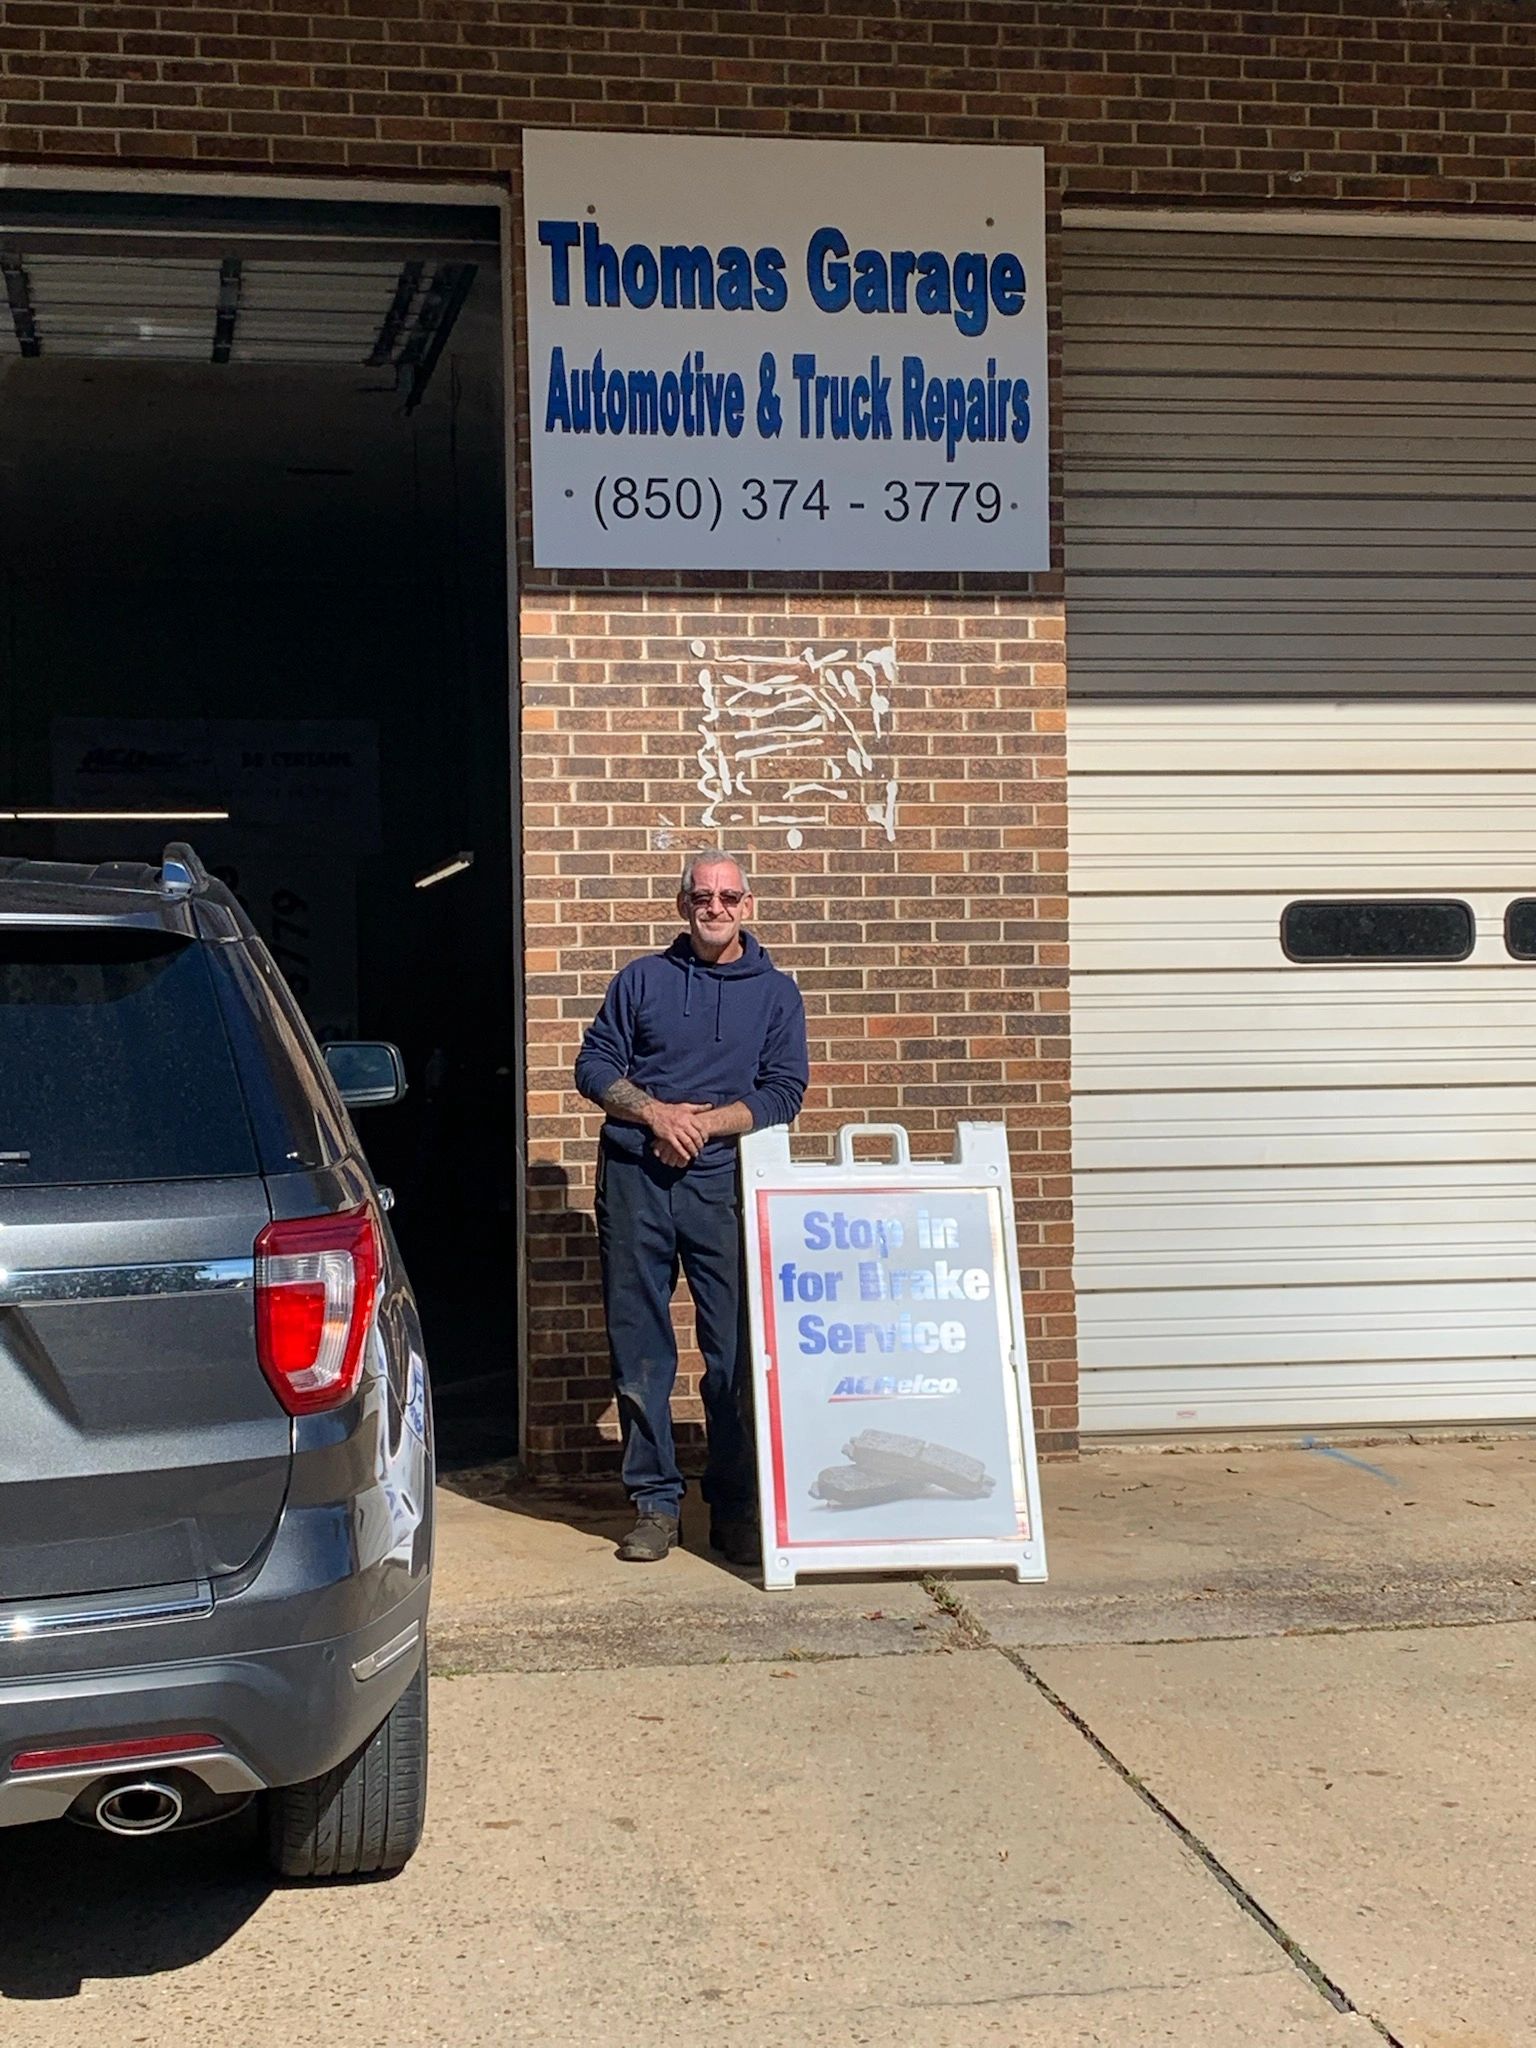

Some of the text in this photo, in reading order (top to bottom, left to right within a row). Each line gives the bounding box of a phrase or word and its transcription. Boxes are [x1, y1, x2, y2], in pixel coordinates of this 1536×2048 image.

[538, 220, 1027, 337] Thomas Garage
[545, 346, 1031, 462] Automotive & Truck Repairs
[594, 477, 723, 532] (850)
[741, 478, 831, 522] 374
[883, 480, 1002, 524] 3779
[804, 1209, 960, 1259] Stop in
[779, 1260, 991, 1303] for Brake
[798, 1313, 967, 1356] Service
